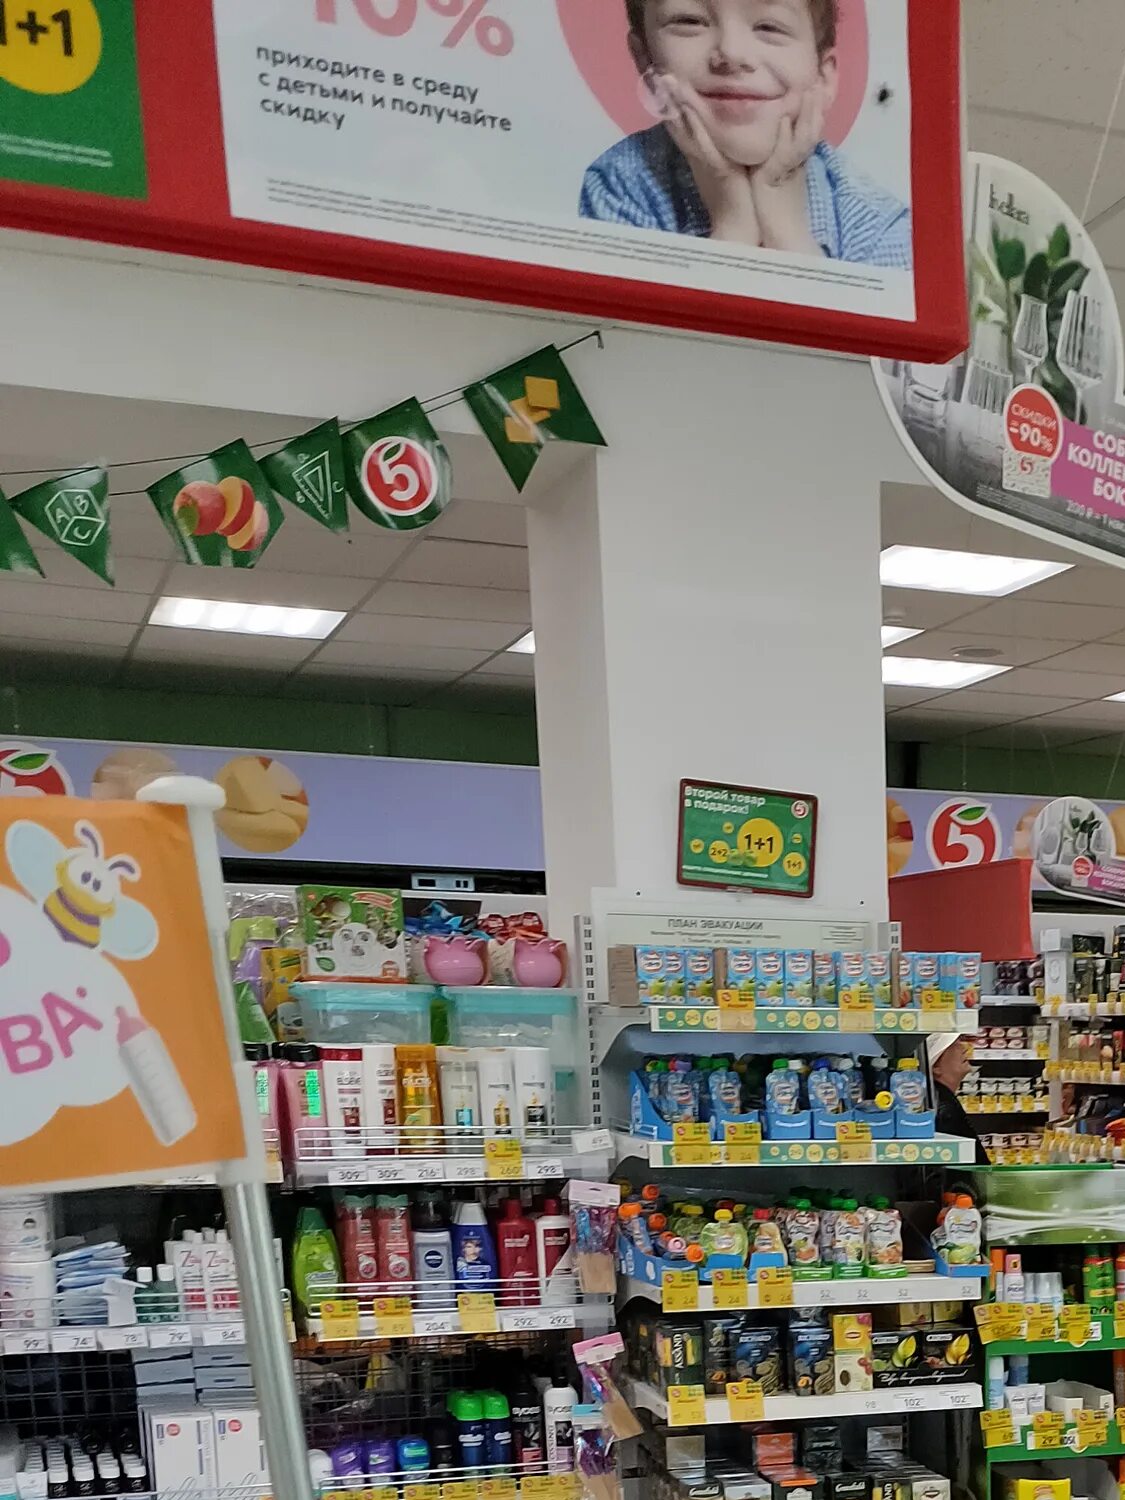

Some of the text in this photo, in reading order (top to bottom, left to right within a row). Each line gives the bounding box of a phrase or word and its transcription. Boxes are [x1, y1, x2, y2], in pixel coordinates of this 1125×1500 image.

[257, 46, 479, 104] приходите в среду
[258, 72, 512, 131] с детьми и получайте
[260, 98, 345, 130] скидку
[730, 794, 766, 808] товар
[744, 833, 774, 854] 1+1
[668, 918, 763, 930] ПЛАН ЭВАКУАЦИИ
